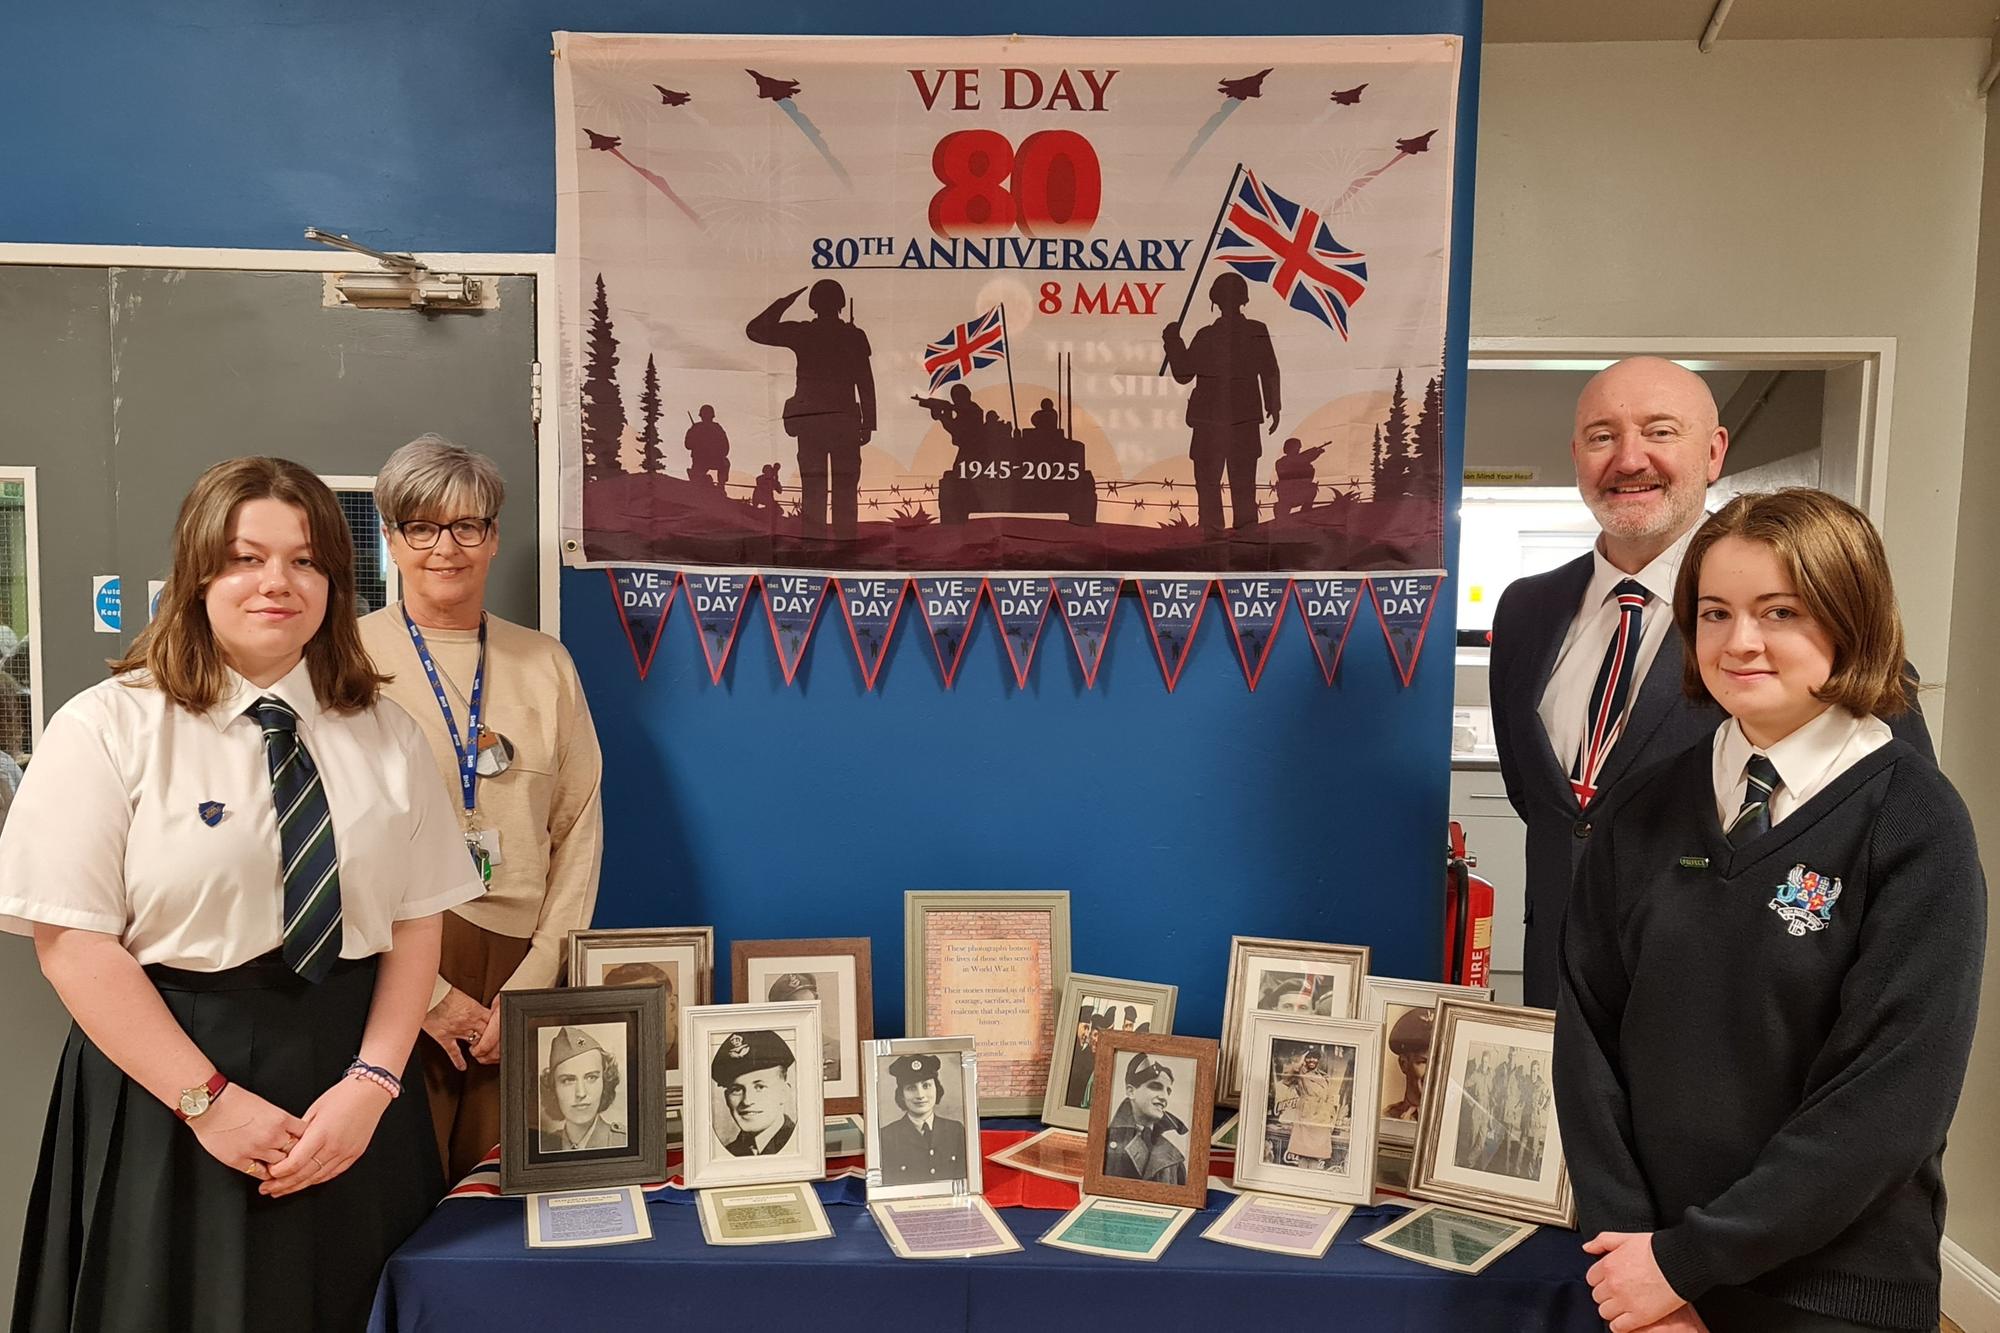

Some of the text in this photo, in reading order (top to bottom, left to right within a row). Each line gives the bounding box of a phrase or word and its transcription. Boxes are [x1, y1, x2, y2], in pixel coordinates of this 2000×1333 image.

[906, 68, 1120, 112] VE DAY
[928, 129, 1101, 240] 80
[811, 236, 1193, 270] 80TH ANNIVERSARY
[1038, 281, 1166, 315] 8 MAY
[957, 459, 1081, 482] 1945-2025
[1477, 472, 1495, 480] Mind
[1496, 472, 1513, 480] Your
[1515, 472, 1533, 480] Head
[632, 573, 659, 589] VE
[704, 577, 731, 593] VE
[781, 578, 808, 594] VE
[935, 581, 963, 597] VE
[1008, 580, 1036, 597] VE
[1074, 580, 1102, 597] VE
[1315, 581, 1343, 597] VE
[1390, 579, 1418, 596] VE
[858, 582, 886, 598] VE
[1160, 583, 1188, 599] VE
[1242, 582, 1269, 598] VE
[623, 591, 665, 608] DAY
[697, 596, 738, 612] DAY
[773, 597, 815, 613] DAY
[1383, 598, 1426, 615] DAY
[851, 601, 893, 617] DAY
[928, 600, 971, 616] DAY
[1001, 600, 1043, 616] DAY
[1068, 600, 1110, 617] DAY
[1153, 602, 1195, 619] DAY
[1235, 601, 1277, 618] DAY
[1308, 600, 1351, 616] DAY
[968, 945, 1007, 953] photographs
[1470, 952, 1483, 987] FIRE
[955, 998, 983, 1006] courage,
[994, 1008, 1017, 1016] shaped
